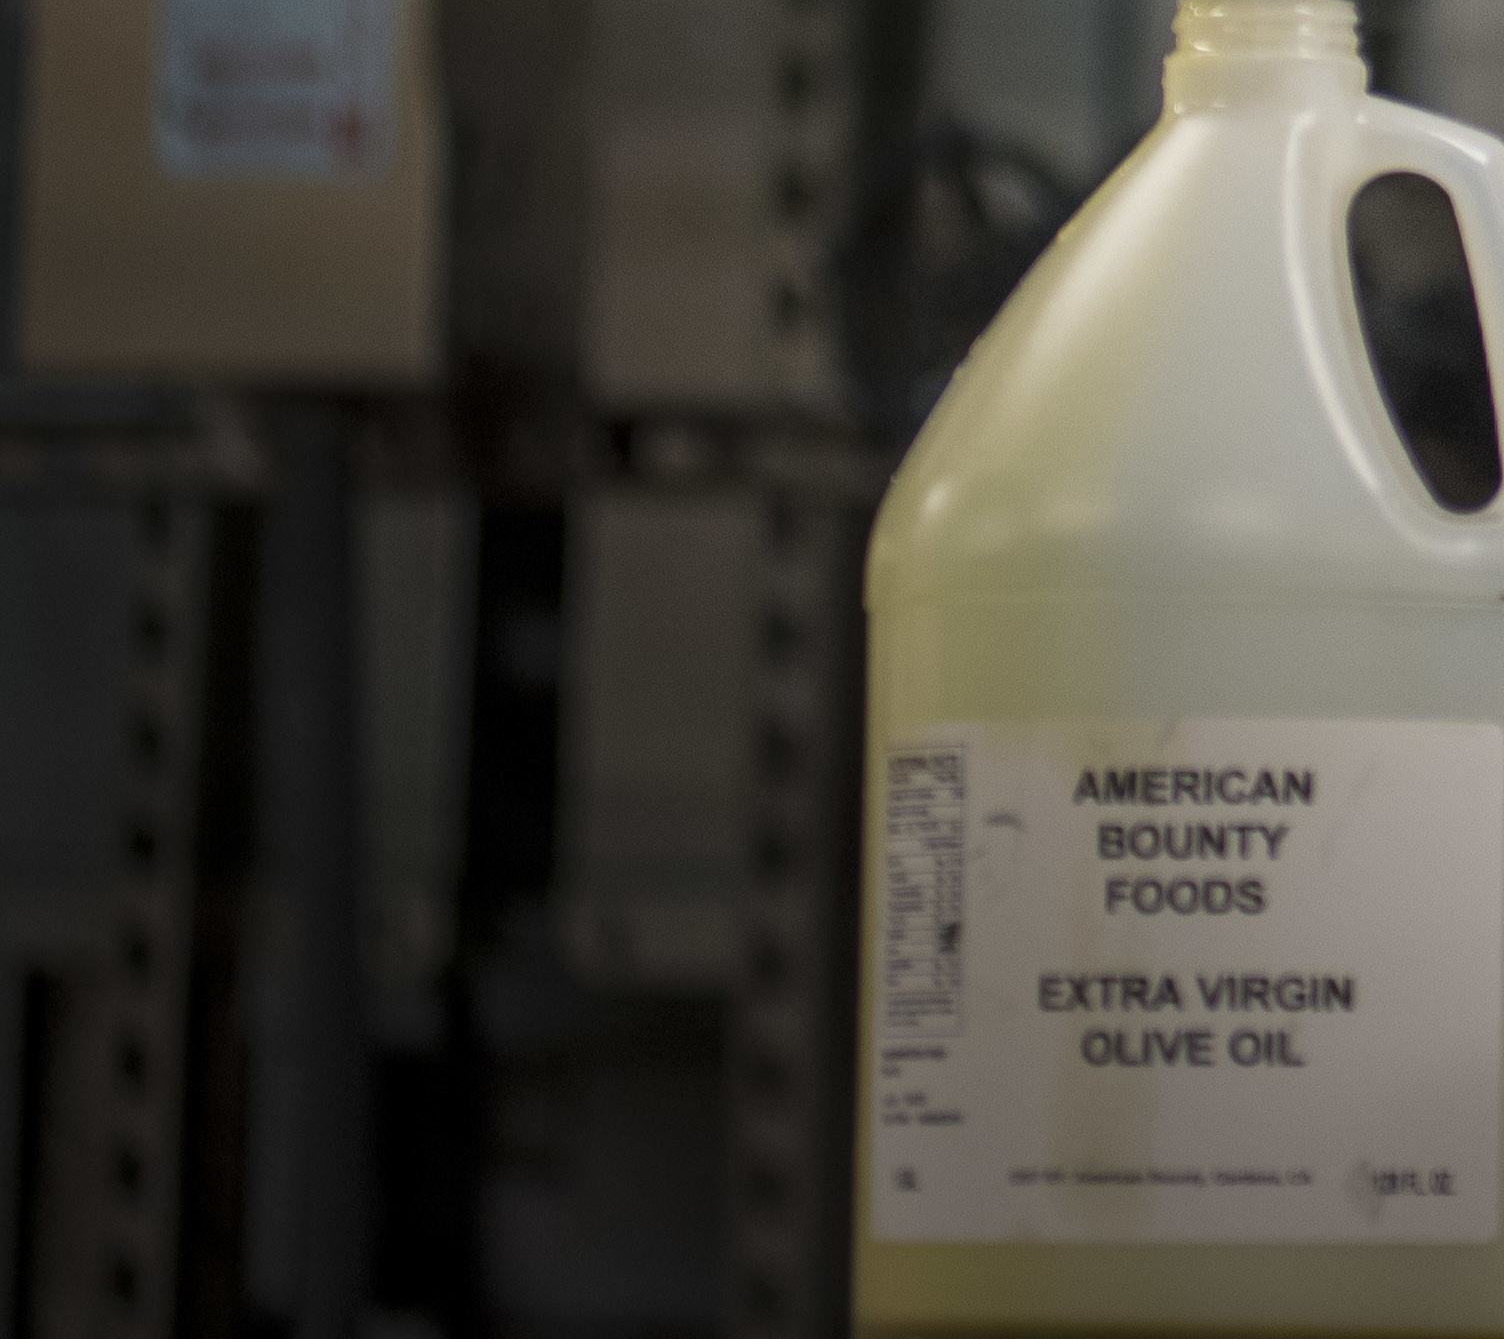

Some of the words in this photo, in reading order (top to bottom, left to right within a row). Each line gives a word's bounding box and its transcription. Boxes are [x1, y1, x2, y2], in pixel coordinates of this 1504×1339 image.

[1074, 769, 1315, 805] AMERICAN
[1098, 824, 1288, 860] BOUNTY
[1105, 878, 1266, 915] FOODS
[1039, 975, 1182, 1012] EXTRA
[1197, 975, 1355, 1012] VIRGIN
[1081, 1029, 1214, 1067] OLIVE
[1228, 1029, 1305, 1067] OIL
